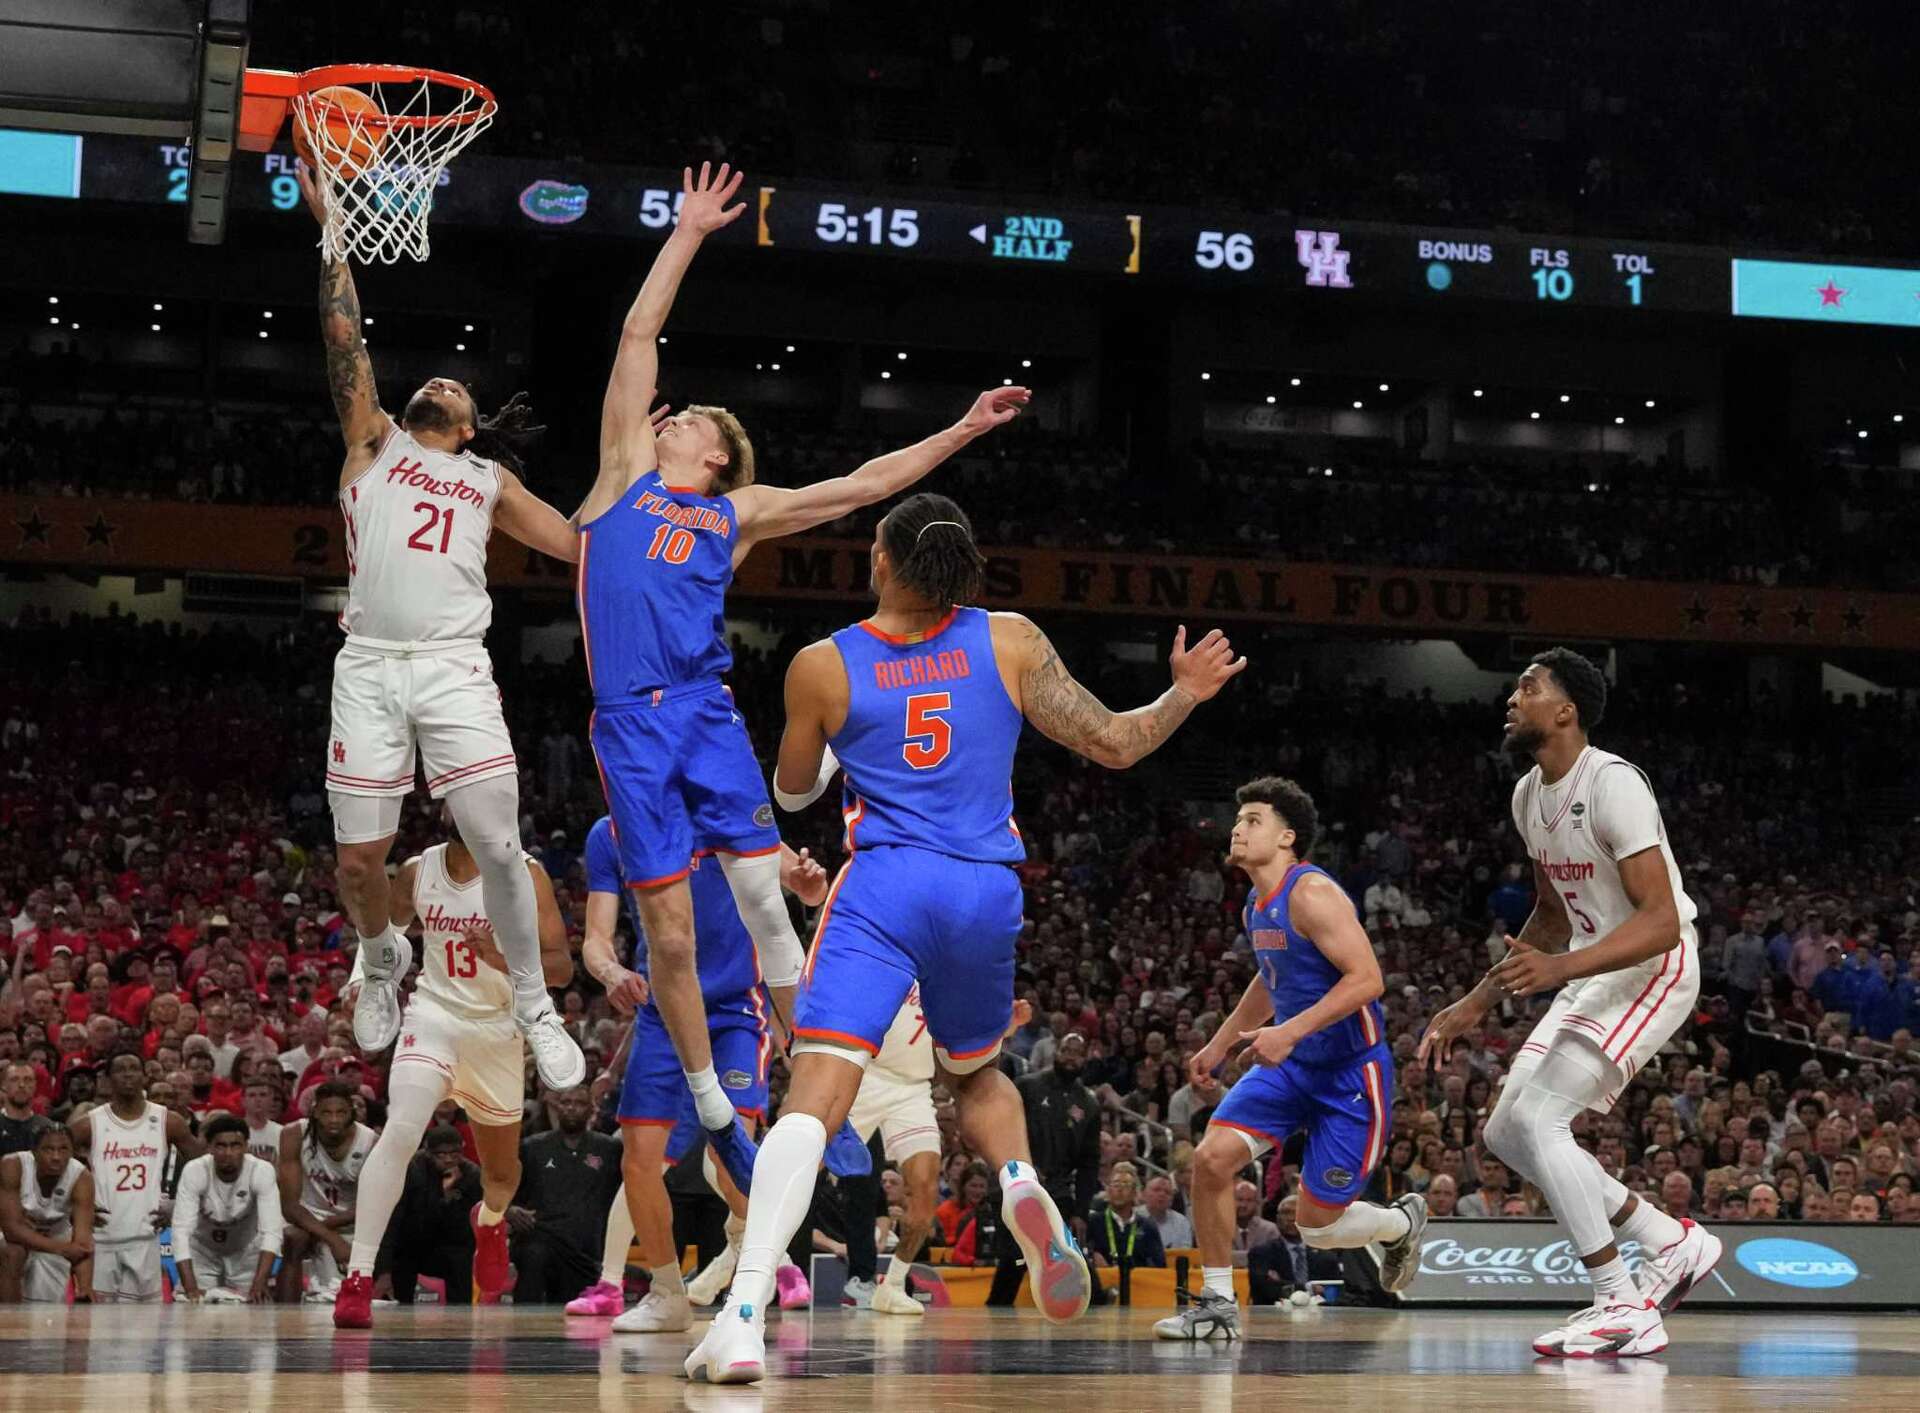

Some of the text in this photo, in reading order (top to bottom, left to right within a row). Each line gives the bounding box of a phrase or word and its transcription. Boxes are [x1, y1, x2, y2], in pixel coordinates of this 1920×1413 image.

[271, 175, 299, 210] 9
[815, 203, 920, 248] 5:15
[1005, 216, 1064, 239] 2ND
[992, 235, 1073, 262] HALF
[1195, 231, 1255, 271] 56
[1418, 240, 1493, 264] BONUS
[1530, 248, 1570, 268] FLS
[1613, 253, 1655, 275] TOL
[1532, 268, 1574, 301] 10
[1625, 275, 1643, 305] 1
[386, 456, 485, 510] Houston
[407, 501, 455, 555] 21
[632, 490, 731, 539] FLORIDA
[646, 523, 697, 565] 10
[1060, 560, 1296, 614] FINAL
[1331, 573, 1530, 624] FOUR
[874, 648, 972, 690] RICHARD
[903, 691, 952, 770] 5
[1563, 891, 1596, 934] 5
[445, 940, 478, 978] 13
[908, 1013, 929, 1046] 7
[103, 1140, 158, 1162] Houston
[115, 1163, 147, 1192] 23
[1465, 1275, 1593, 1284] ZERO SUG
[1755, 1260, 1859, 1276] NCAA
